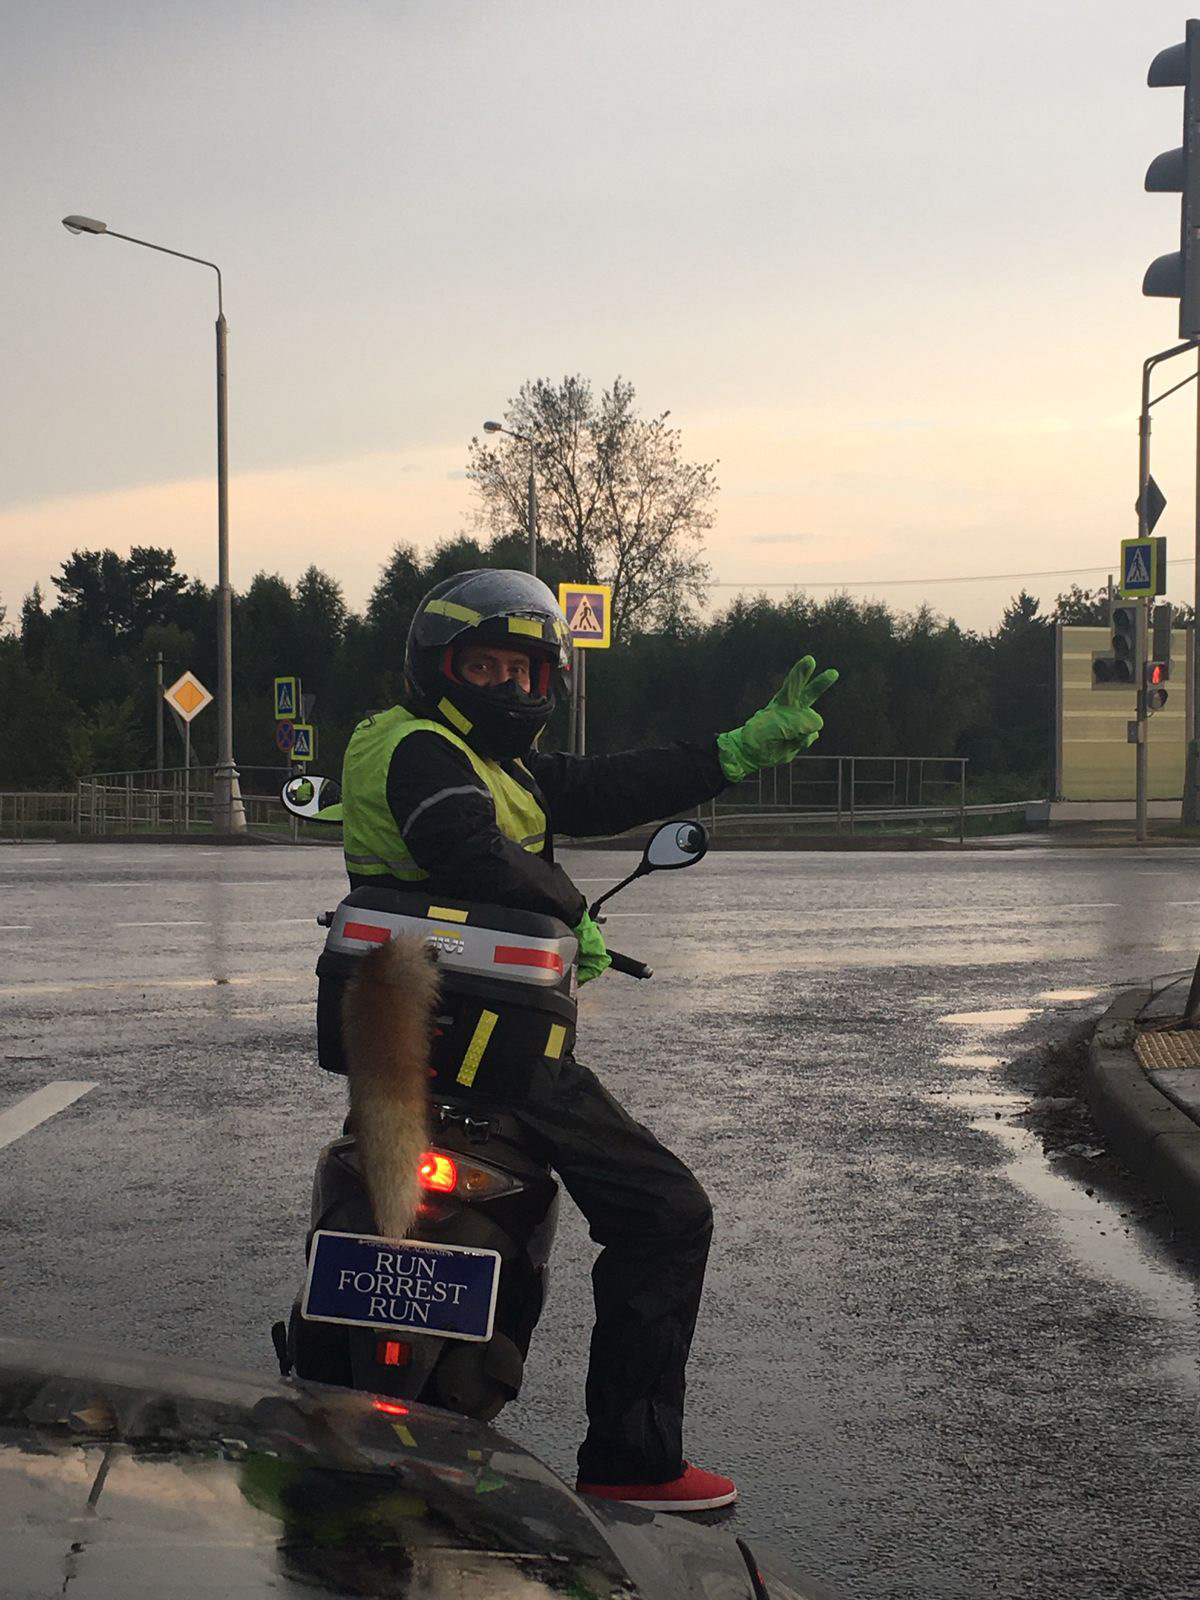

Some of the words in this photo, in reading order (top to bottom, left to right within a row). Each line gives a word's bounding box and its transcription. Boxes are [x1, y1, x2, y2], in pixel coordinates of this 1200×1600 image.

[375, 1252, 437, 1278] RUN
[338, 1270, 468, 1304] FORREST
[368, 1296, 430, 1323] RUN
